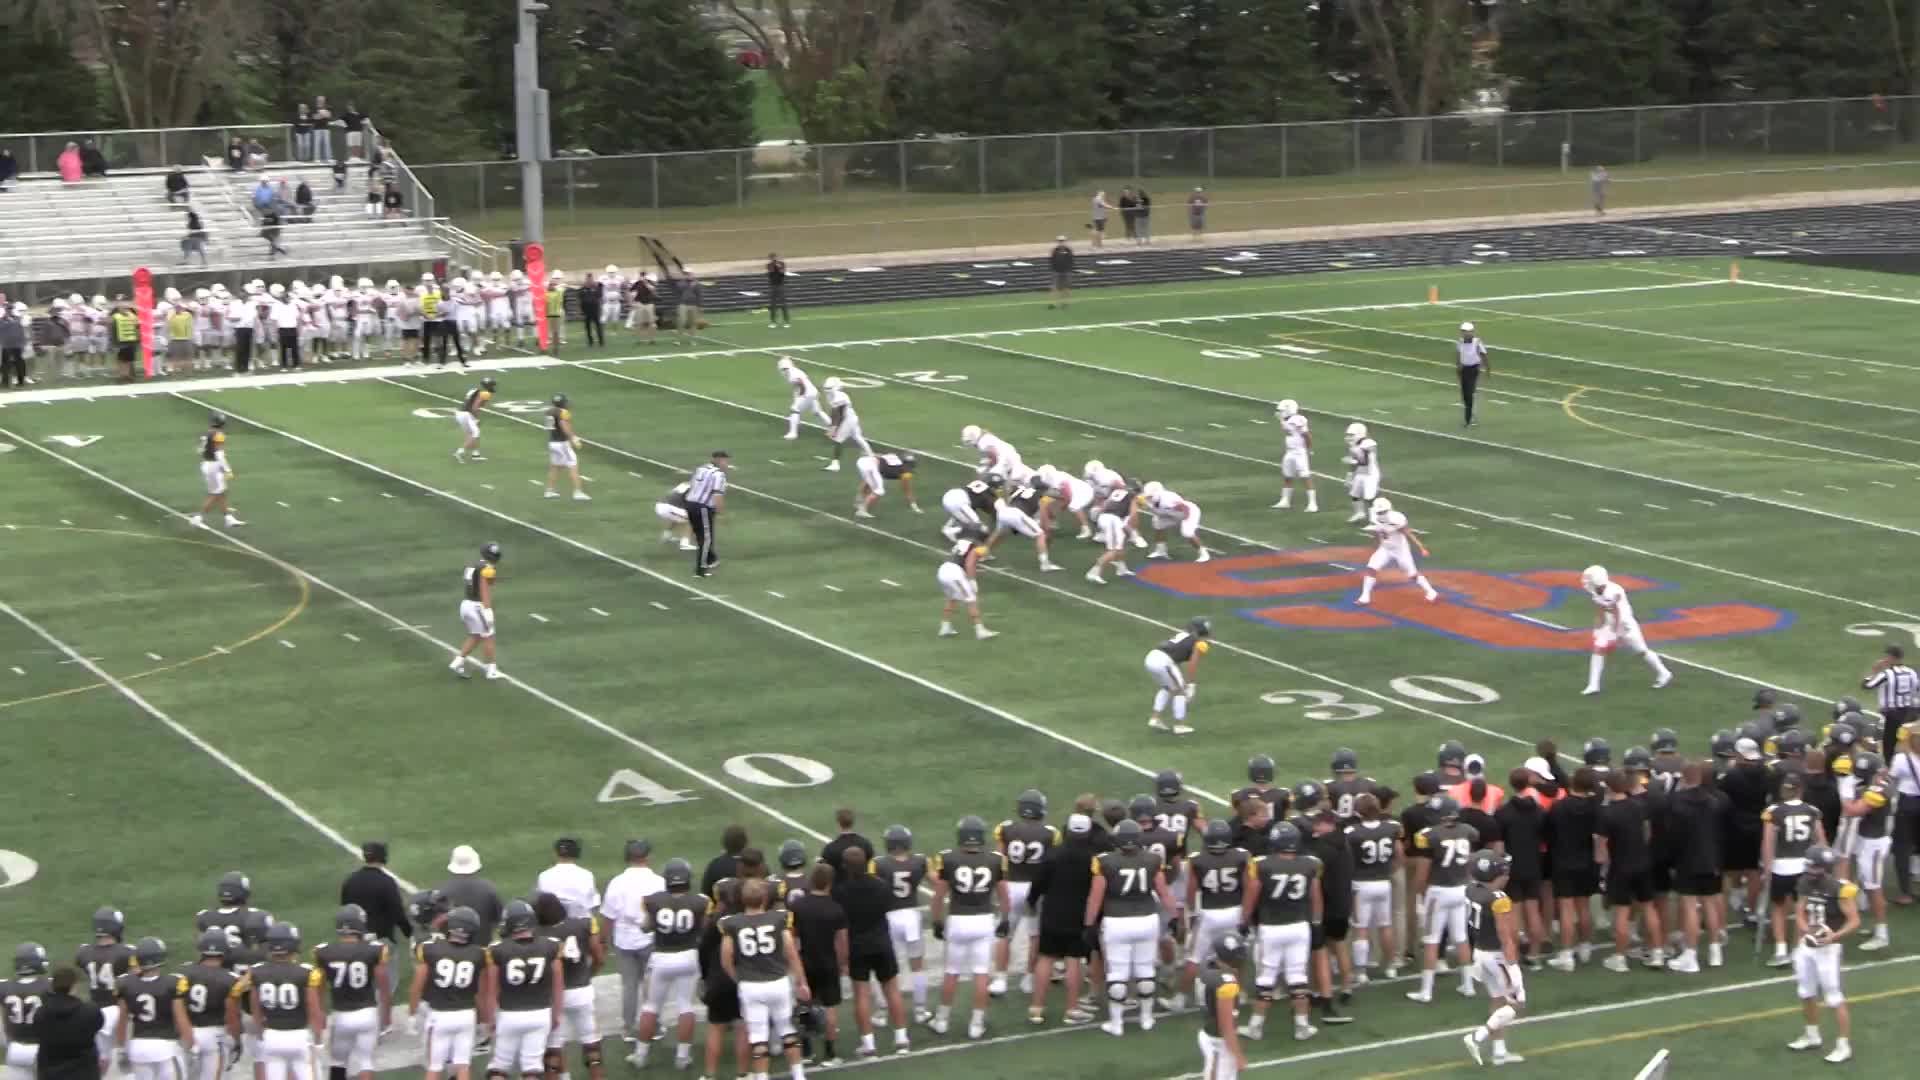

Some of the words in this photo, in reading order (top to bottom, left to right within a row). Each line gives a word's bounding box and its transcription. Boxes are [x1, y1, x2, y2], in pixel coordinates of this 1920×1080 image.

[1784, 815, 1810, 842] 15
[1361, 838, 1393, 865] 36
[1441, 838, 1471, 867] 79
[893, 871, 911, 898] 5
[955, 866, 992, 893] 92
[1119, 867, 1149, 896] 71
[1202, 868, 1238, 893] 45
[1270, 874, 1307, 900] 73
[656, 908, 695, 935] 90
[738, 925, 776, 957] 65
[87, 961, 115, 991] 14
[328, 961, 369, 989] 78
[434, 958, 475, 988] 98
[506, 957, 546, 985] 67
[136, 993, 156, 1022] 3
[189, 984, 208, 1013] 9
